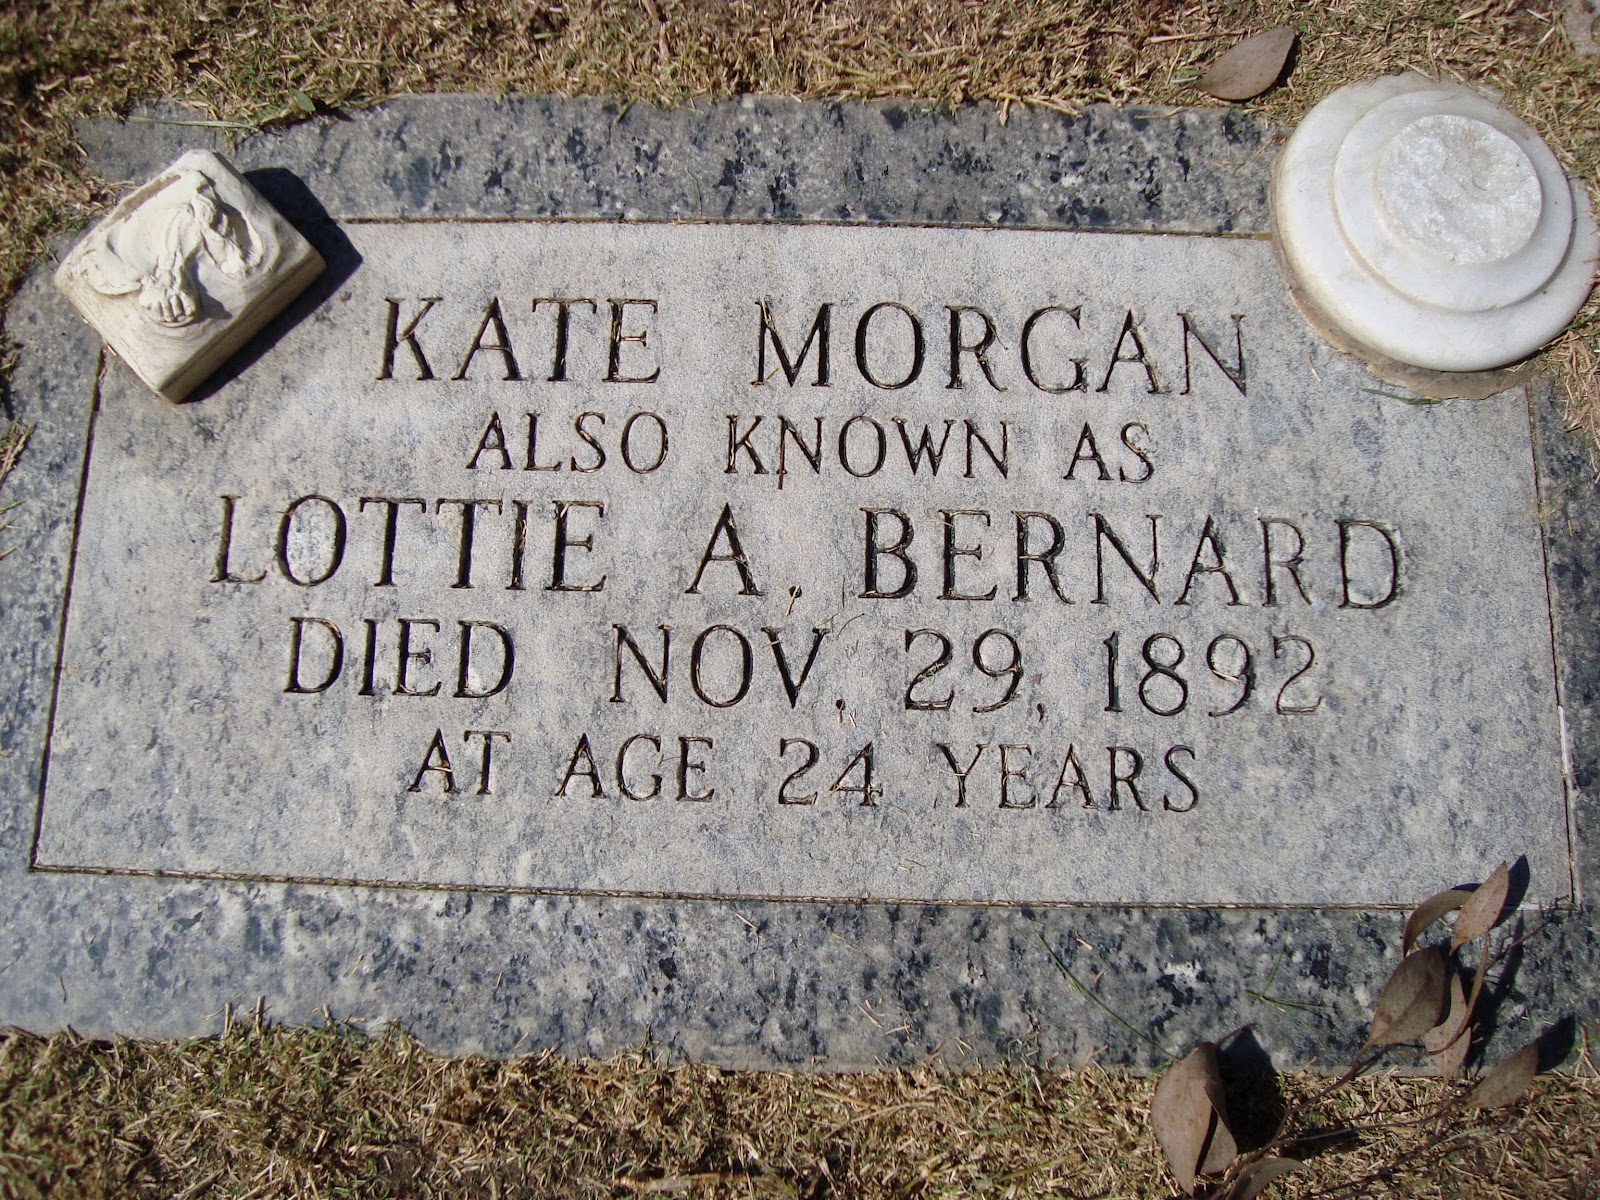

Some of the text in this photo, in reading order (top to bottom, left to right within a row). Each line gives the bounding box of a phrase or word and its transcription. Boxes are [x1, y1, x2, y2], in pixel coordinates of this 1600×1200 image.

[376, 296, 1247, 397] KATE MORGAN
[466, 411, 1156, 483] ALSO KNOWN AS
[210, 495, 1402, 610] LOTTIE A. BERNARD
[283, 616, 1323, 722] DIED NOV. 29, 1892
[406, 728, 1200, 813] AT AGE 24 YEARS
